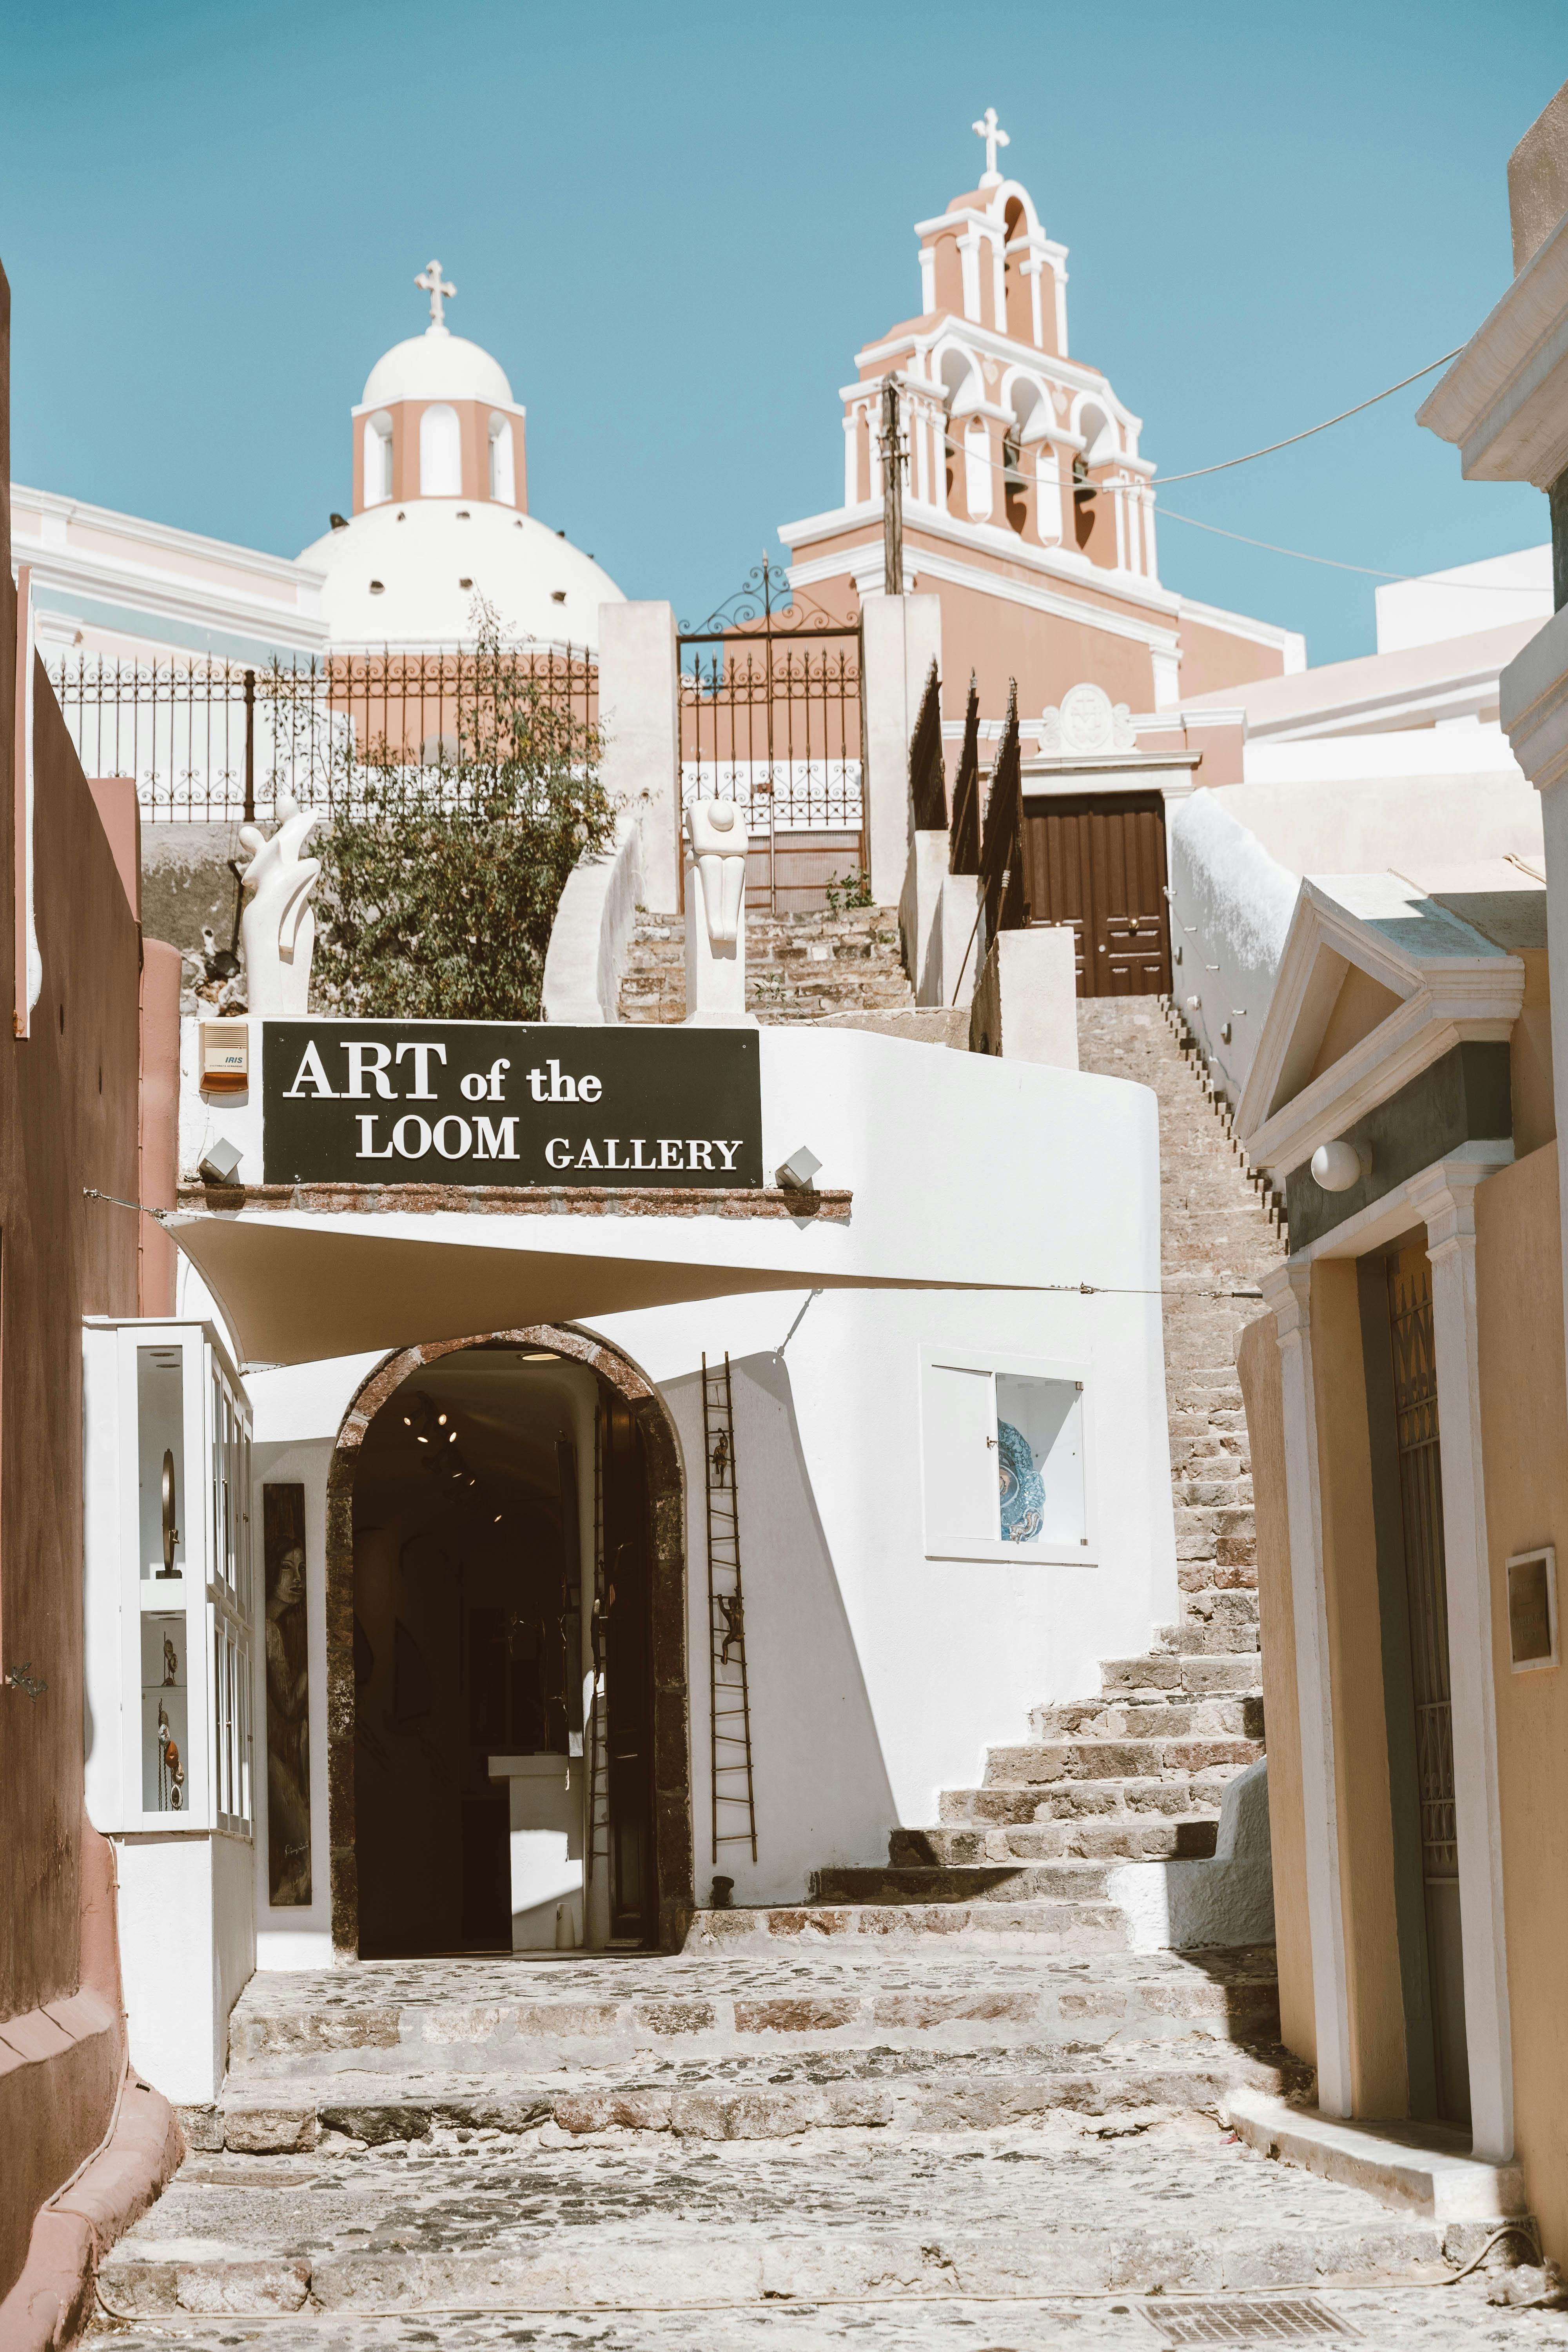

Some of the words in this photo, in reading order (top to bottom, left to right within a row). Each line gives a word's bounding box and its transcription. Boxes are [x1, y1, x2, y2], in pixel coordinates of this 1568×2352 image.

[283, 1040, 446, 1099] ART
[461, 1058, 510, 1101] of
[526, 1059, 602, 1102] the
[356, 1115, 520, 1159] LOOM
[545, 1138, 743, 1169] GALLERY
